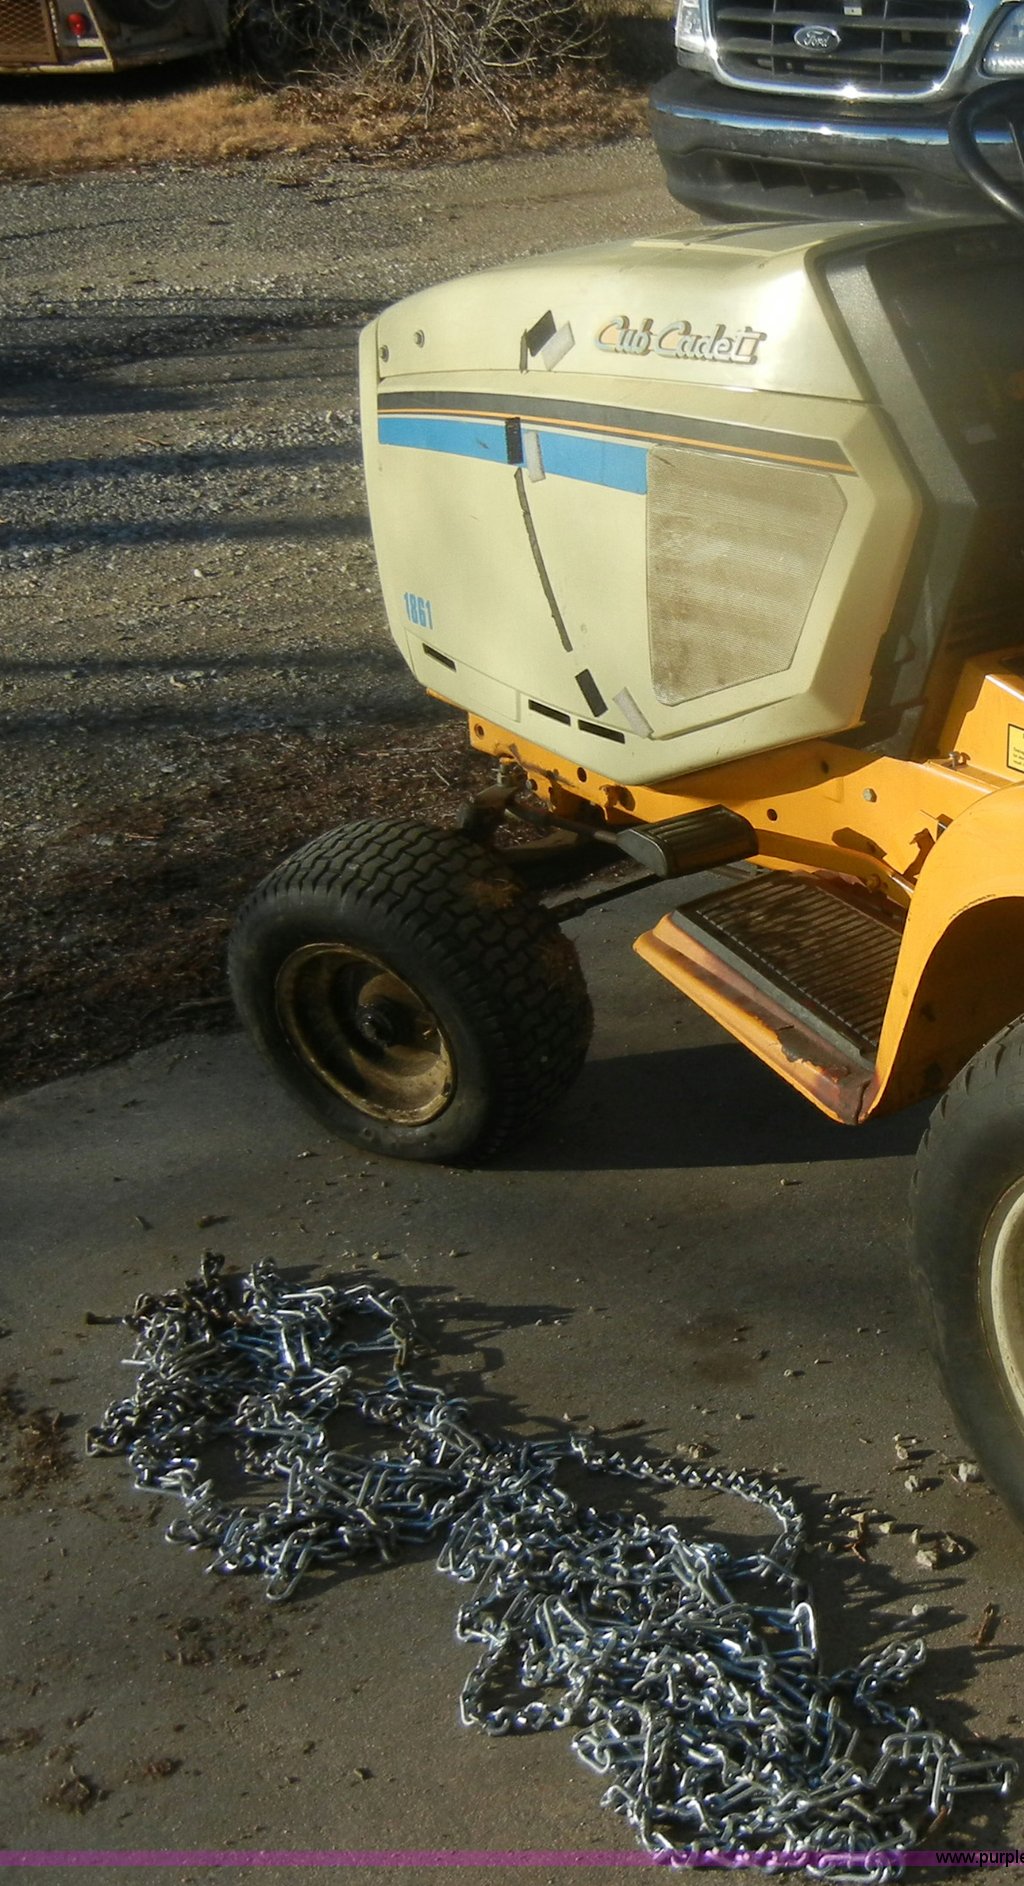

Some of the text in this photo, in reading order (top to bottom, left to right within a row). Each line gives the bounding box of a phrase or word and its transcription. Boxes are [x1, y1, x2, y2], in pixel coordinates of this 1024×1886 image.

[803, 31, 830, 48] Ford
[594, 315, 767, 365] Cub Cadet
[404, 591, 433, 630] 1861
